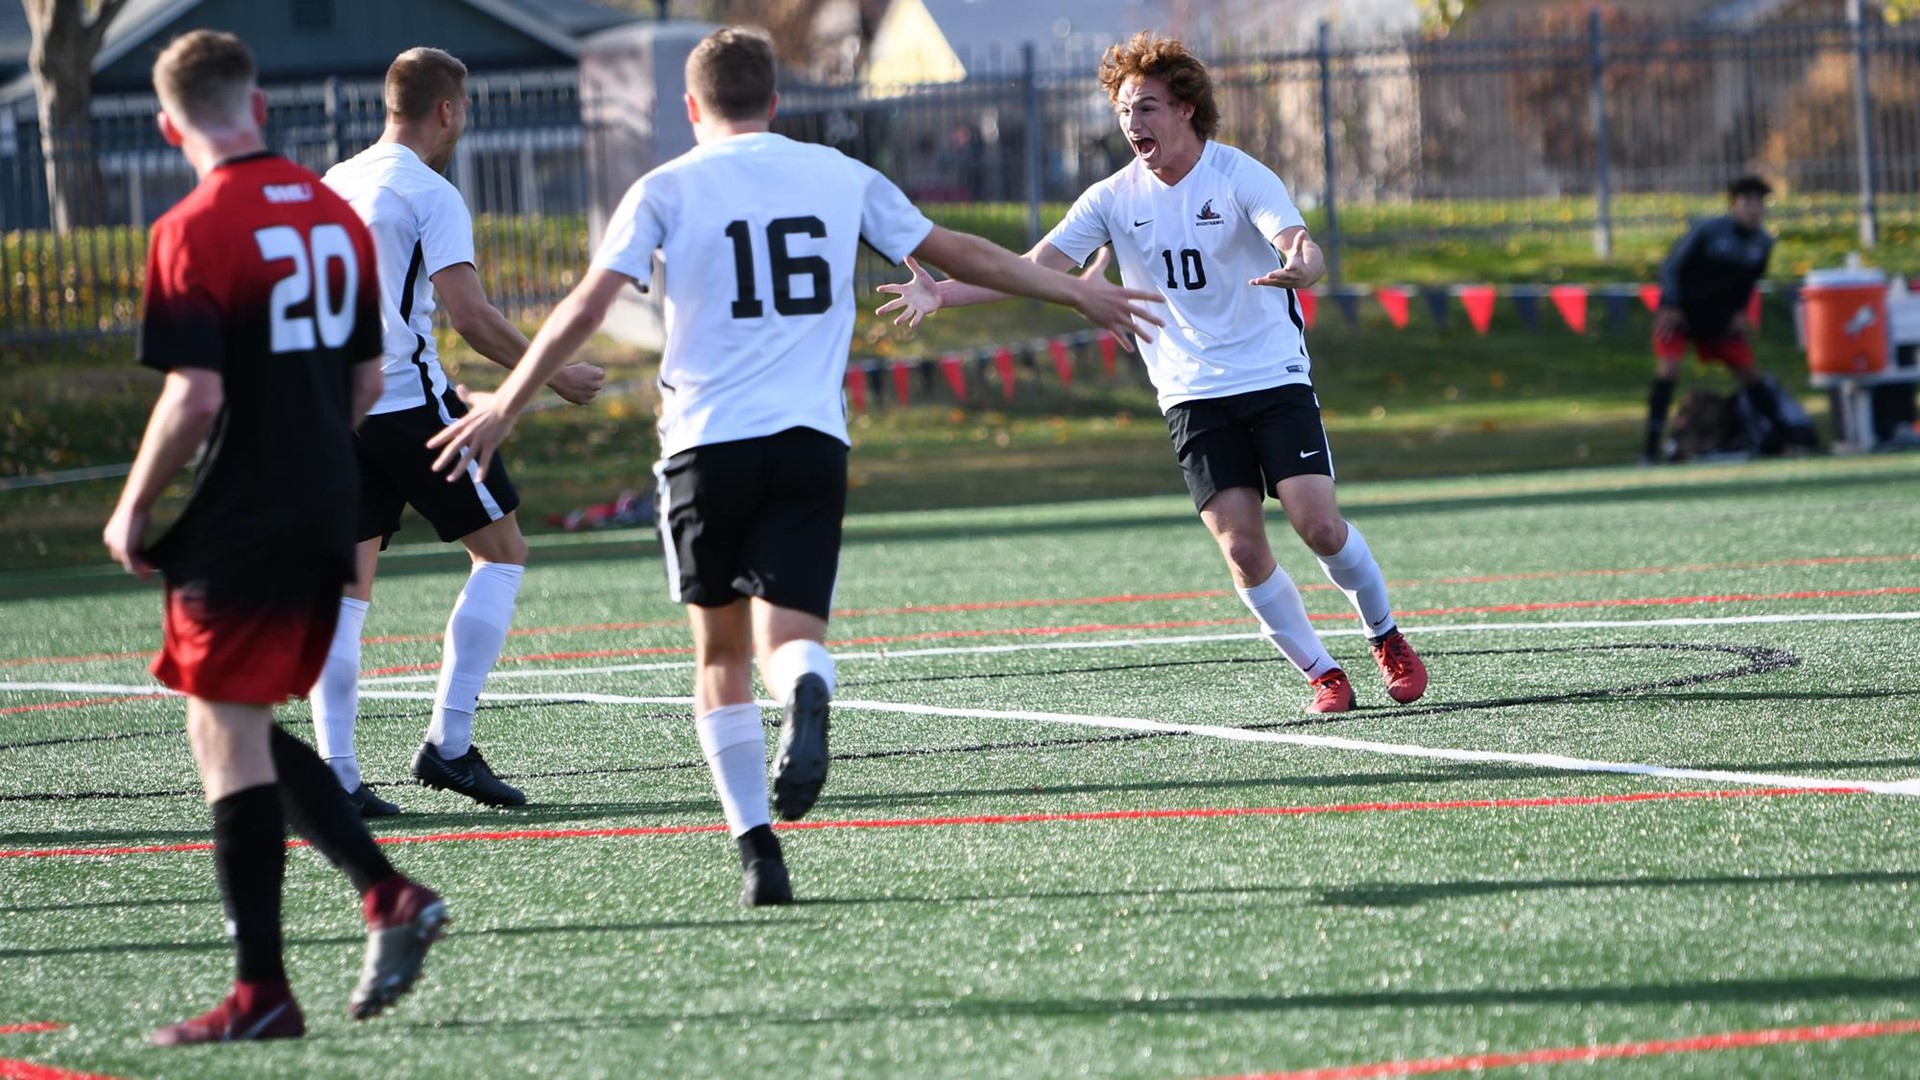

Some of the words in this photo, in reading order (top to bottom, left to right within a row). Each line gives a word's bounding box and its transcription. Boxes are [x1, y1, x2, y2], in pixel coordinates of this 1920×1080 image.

[254, 224, 359, 354] 20
[725, 215, 832, 319] 16
[1162, 248, 1207, 290] 10
